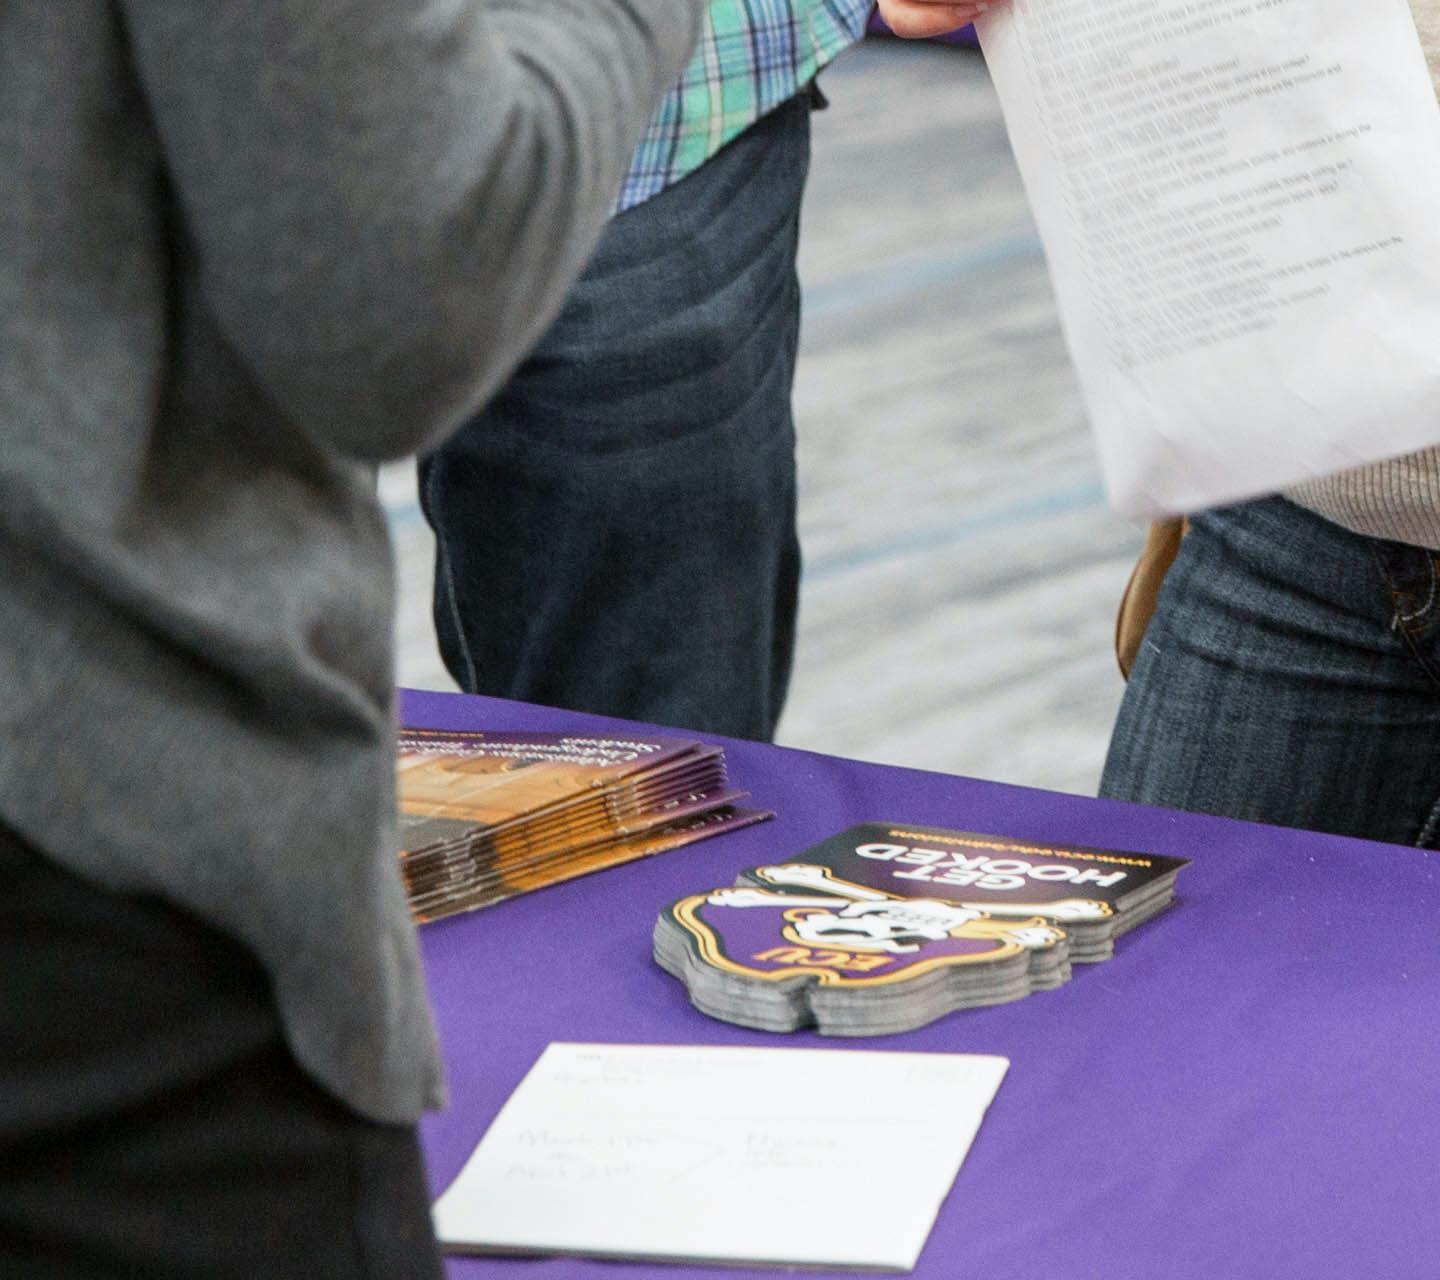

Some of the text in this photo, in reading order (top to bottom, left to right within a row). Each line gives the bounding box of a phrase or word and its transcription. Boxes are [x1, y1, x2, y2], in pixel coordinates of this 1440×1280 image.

[855, 842, 1127, 888] HOOKED
[892, 863, 1026, 891] GET
[751, 944, 897, 972] ECU
